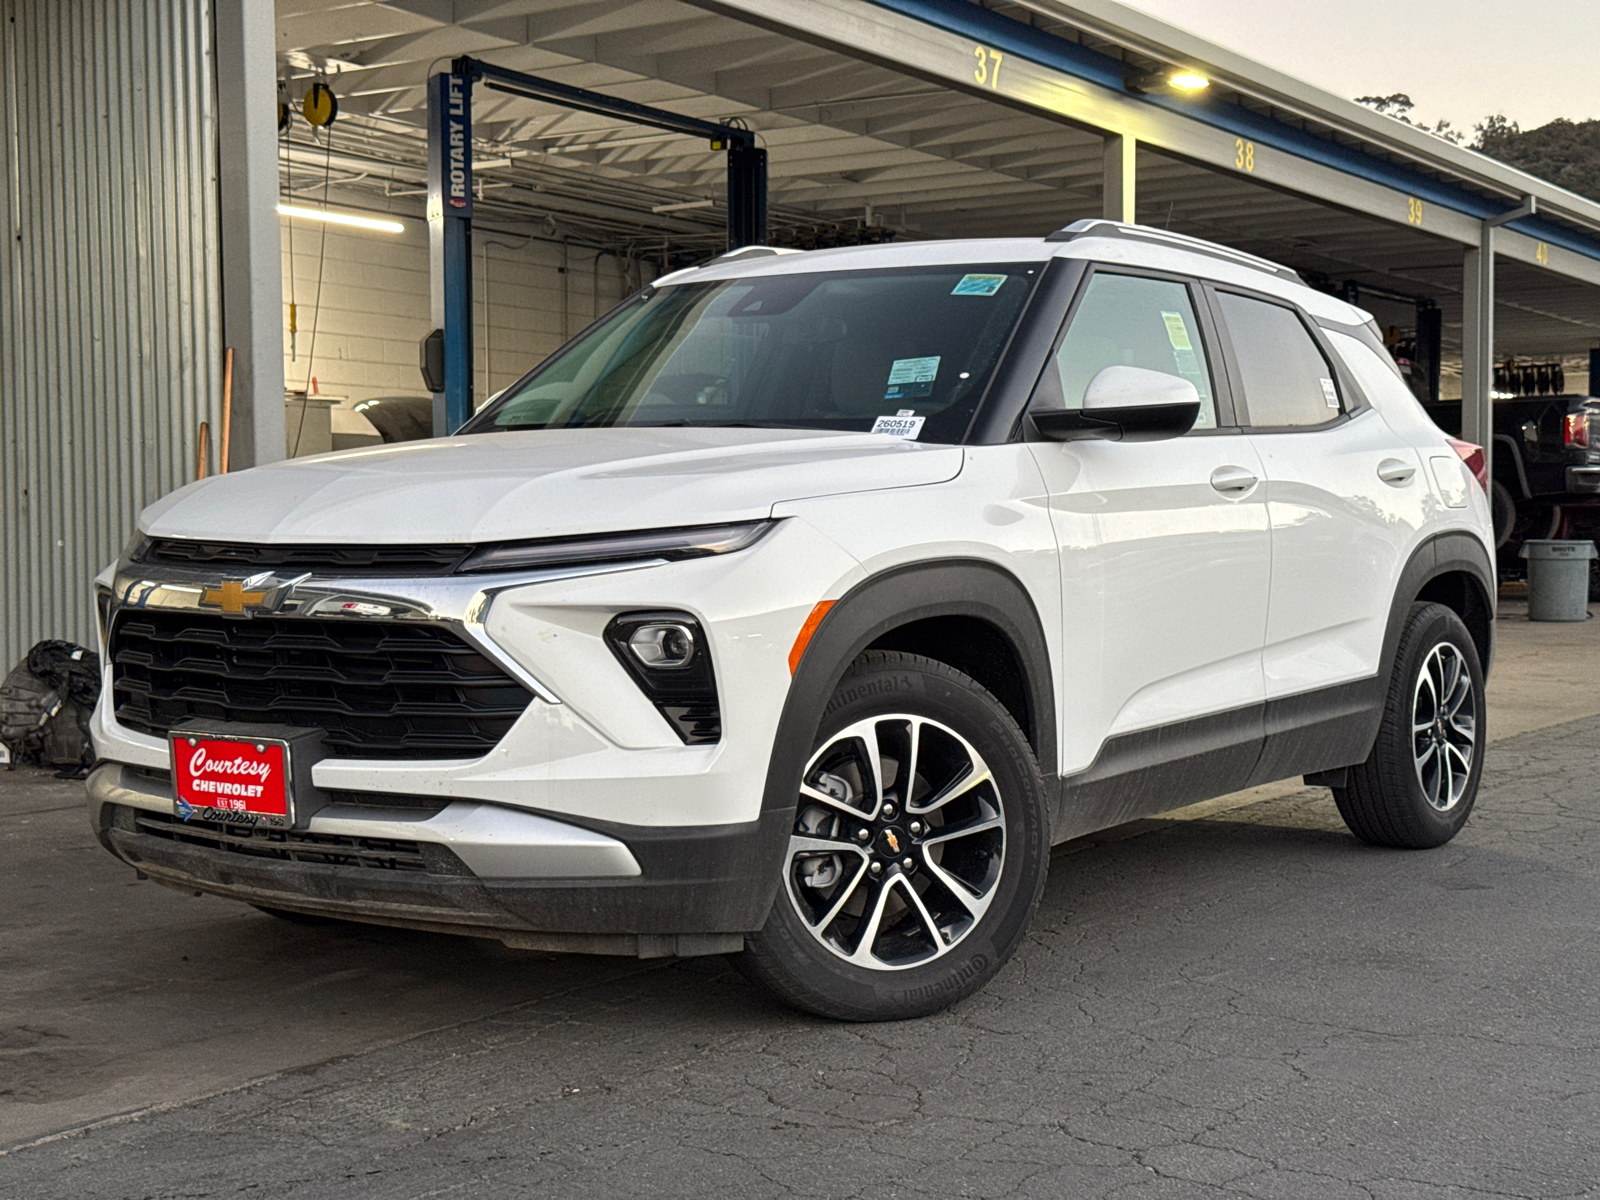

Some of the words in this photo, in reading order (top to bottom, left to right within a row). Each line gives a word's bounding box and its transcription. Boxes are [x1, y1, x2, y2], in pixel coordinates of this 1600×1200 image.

[974, 46, 1003, 89] 37
[449, 74, 464, 116] LIFT
[450, 120, 465, 198] ROTARY
[1235, 138, 1254, 172] 38
[1408, 197, 1422, 225] 39
[1536, 242, 1548, 265] 40
[877, 419, 916, 429] 260519
[821, 675, 900, 720] ntinental
[189, 747, 272, 783] Courtesy
[192, 779, 264, 797] CHEVROLET
[229, 799, 247, 811] 1961
[203, 806, 260, 828] Courtesy
[903, 953, 989, 1001] Continental
